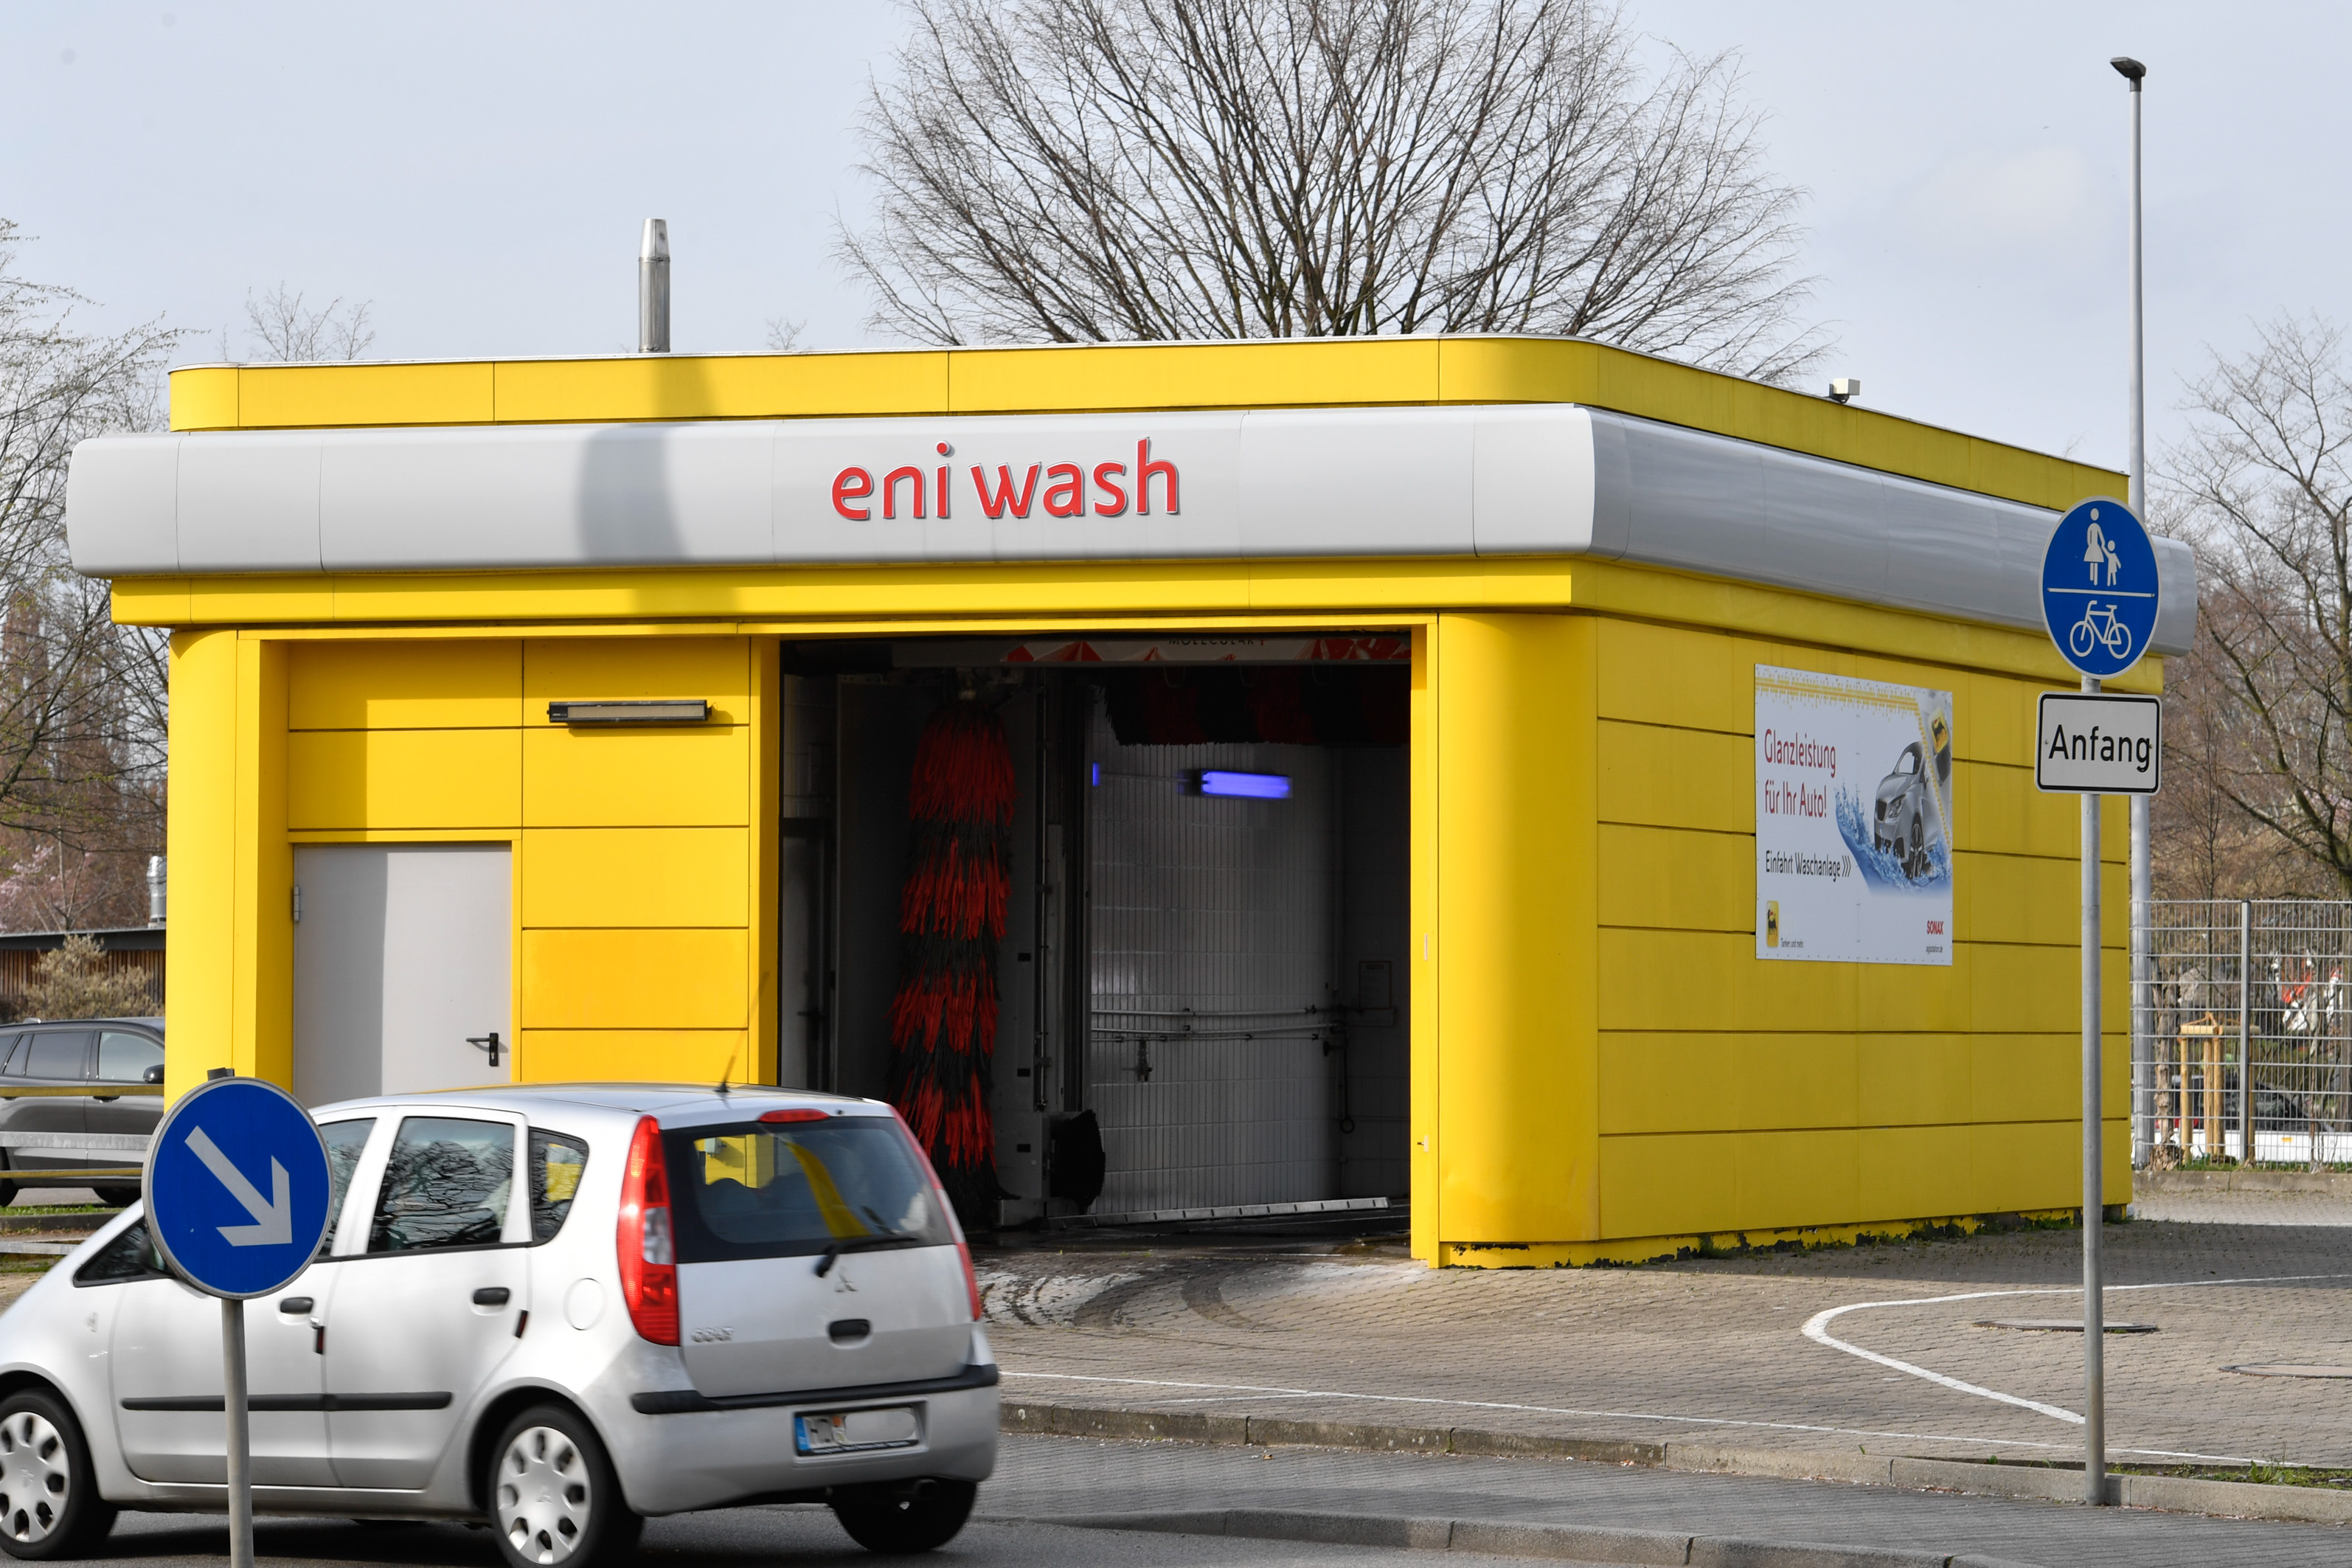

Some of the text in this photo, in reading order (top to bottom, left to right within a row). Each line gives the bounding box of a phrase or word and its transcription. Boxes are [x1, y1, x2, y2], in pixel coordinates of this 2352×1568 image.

[830, 436, 1182, 521] eni wash
[1764, 728, 1836, 779] Glanzleistung
[2048, 724, 2150, 773] Anfang
[1765, 779, 1827, 819] für Ihr Auto!
[1766, 850, 1841, 883] Einfahrt Waschanlage
[1926, 920, 1944, 935] SONAX
